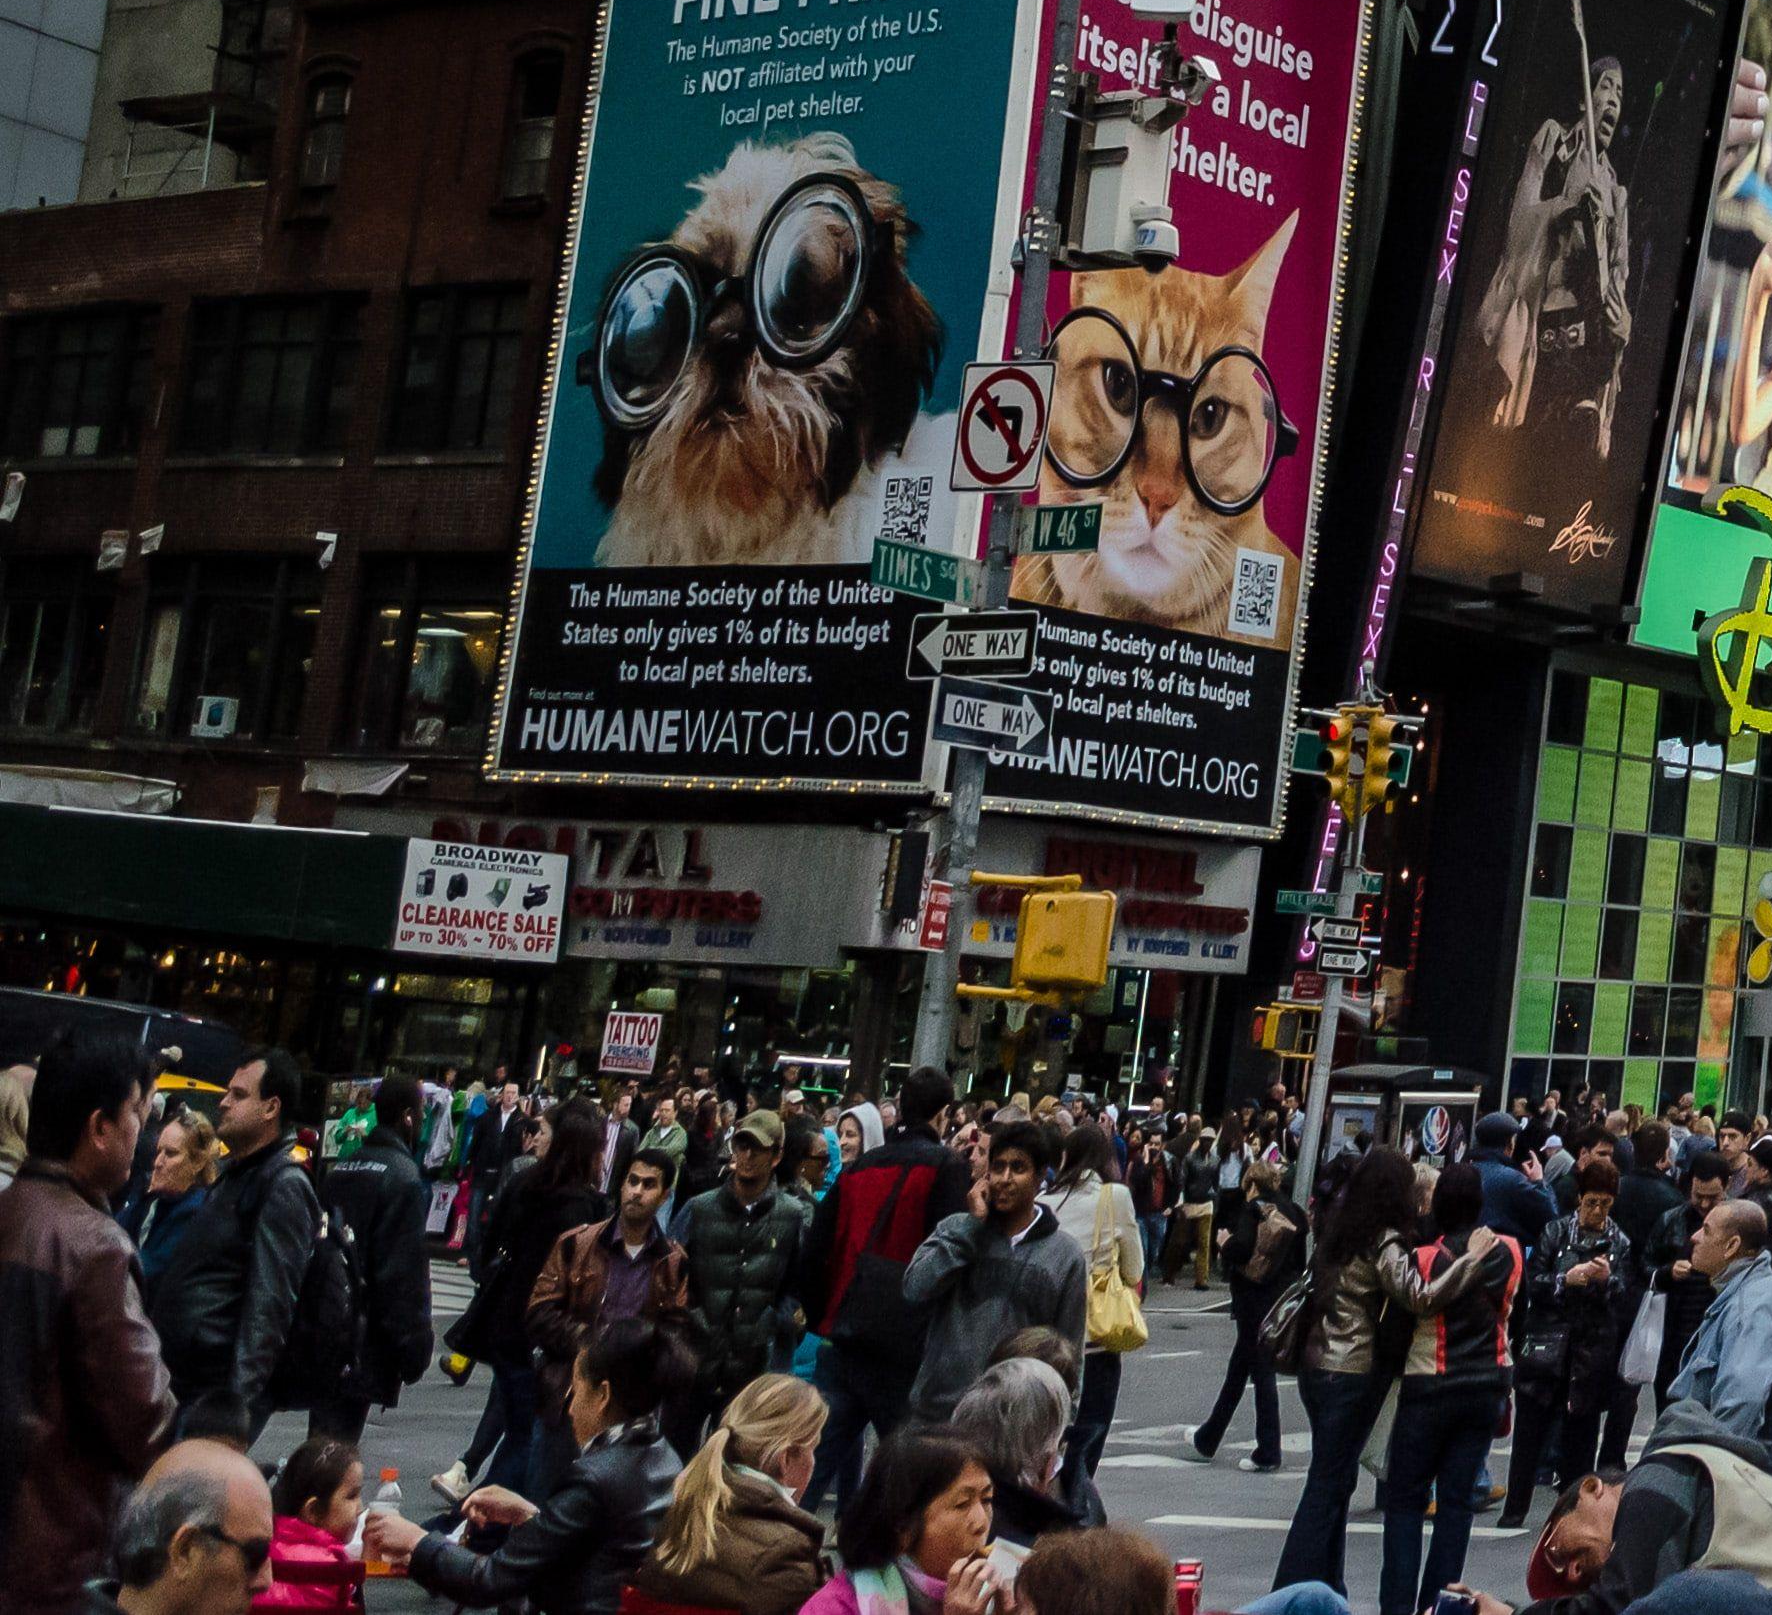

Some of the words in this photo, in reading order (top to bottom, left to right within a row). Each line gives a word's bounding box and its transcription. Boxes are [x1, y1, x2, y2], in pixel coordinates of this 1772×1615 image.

[667, 40, 696, 64] The
[701, 29, 771, 59] Humane
[777, 23, 841, 51] Society
[848, 16, 867, 42] of
[870, 14, 900, 38] the
[907, 9, 943, 34] U.S.
[1039, 515, 1053, 547] W
[1057, 511, 1077, 546] 46
[1083, 507, 1098, 527] ST
[877, 544, 933, 592] TIMES
[943, 634, 975, 657] ONE
[986, 632, 1021, 656] WAY
[520, 708, 910, 758] HUMANEWATCH.ORG
[435, 844, 543, 867] BROADWAY
[402, 903, 509, 932] CLEARANCE
[514, 913, 558, 936] SALE
[606, 1014, 659, 1046] TATTOO
